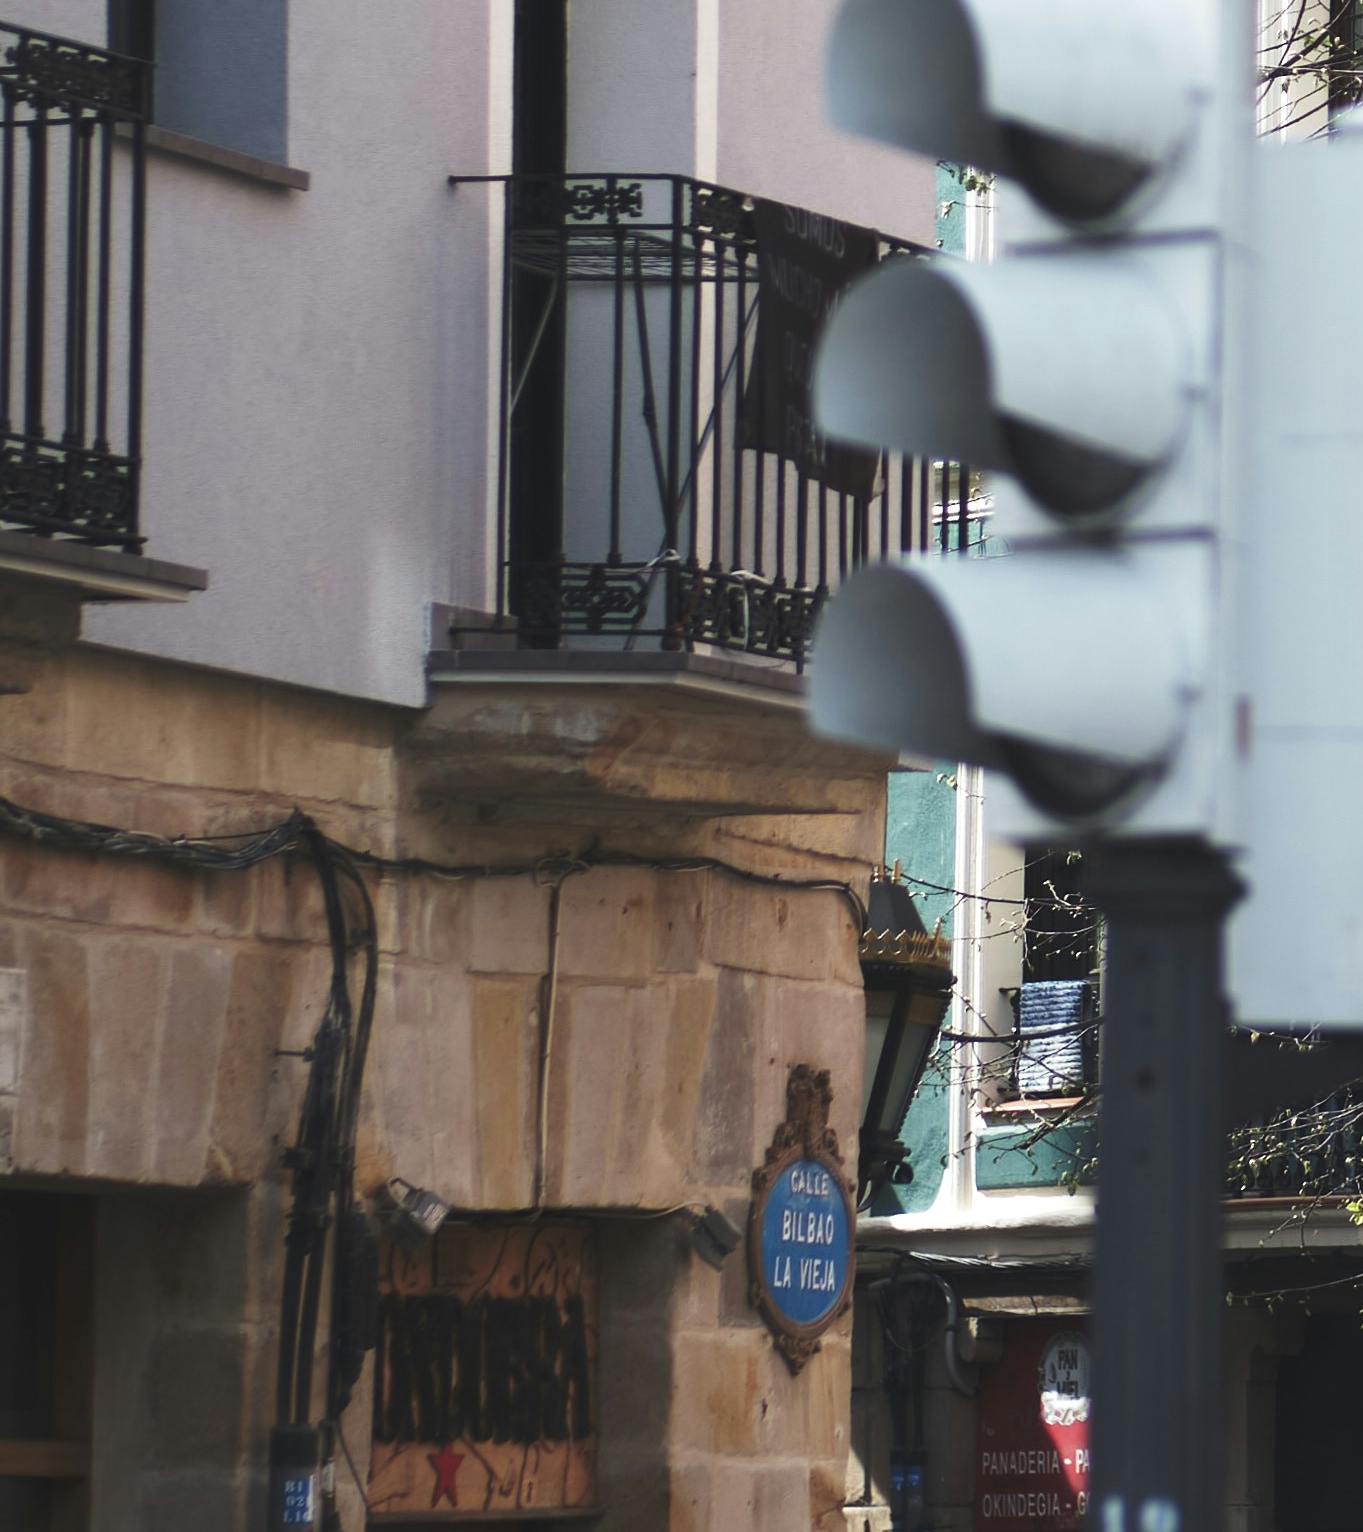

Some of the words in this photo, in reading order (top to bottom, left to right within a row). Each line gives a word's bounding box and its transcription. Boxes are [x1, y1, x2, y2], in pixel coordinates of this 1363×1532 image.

[791, 1170, 829, 1196] CALLE
[782, 1209, 835, 1244] BILBAO
[774, 1256, 792, 1288] LA
[800, 1258, 835, 1291] VIEJA
[1058, 1349, 1078, 1370] PAN
[982, 1451, 1060, 1475] PANADERIA
[982, 1493, 1061, 1519] OKINDEGIA
